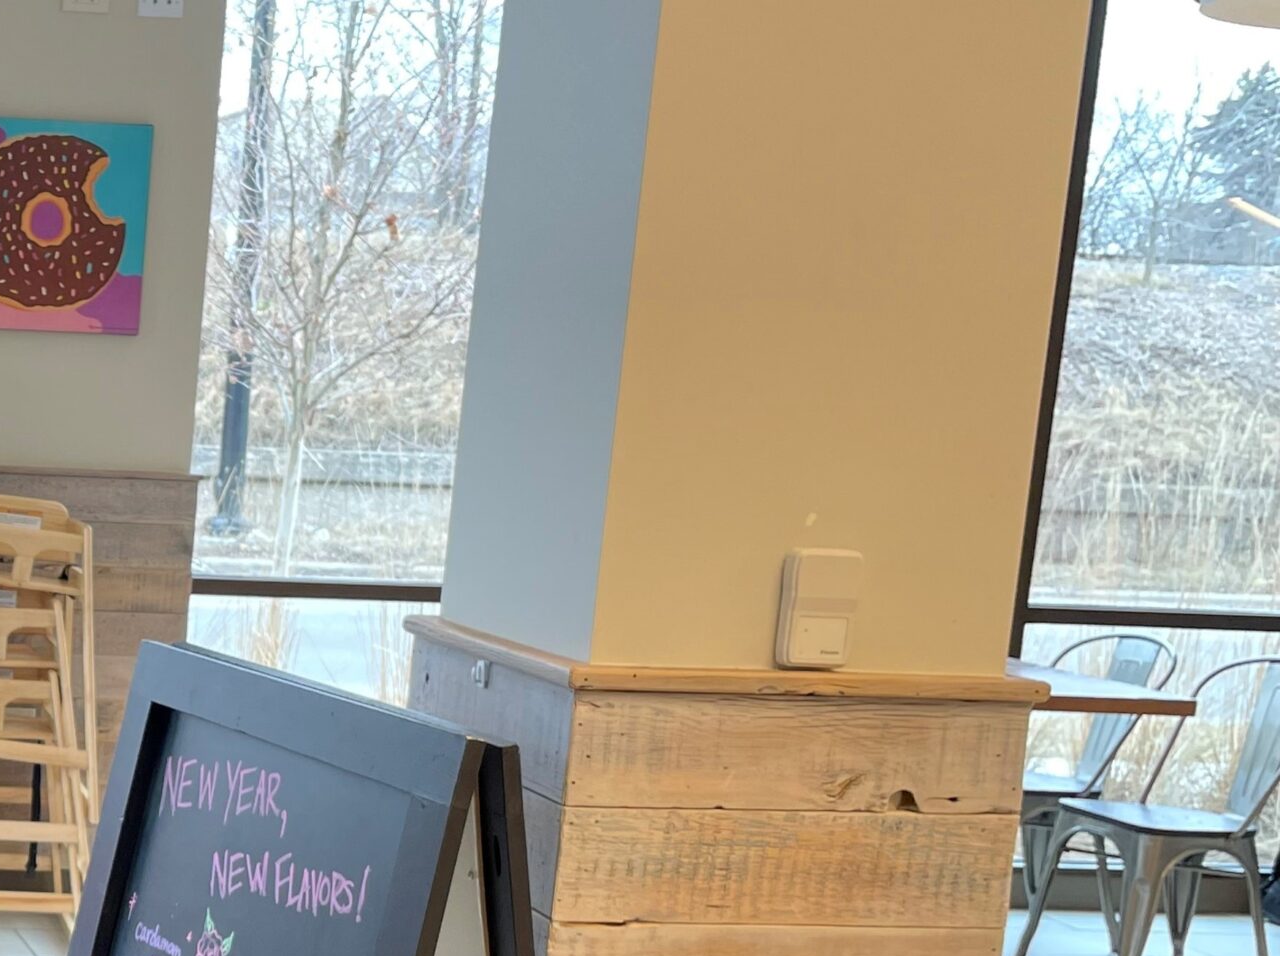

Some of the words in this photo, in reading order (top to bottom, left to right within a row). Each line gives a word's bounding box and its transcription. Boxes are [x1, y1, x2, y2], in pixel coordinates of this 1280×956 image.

[158, 755, 219, 817] NEW
[223, 760, 287, 838] YEAR,
[210, 850, 269, 899] NEW
[274, 852, 371, 923] FLAVORS!
